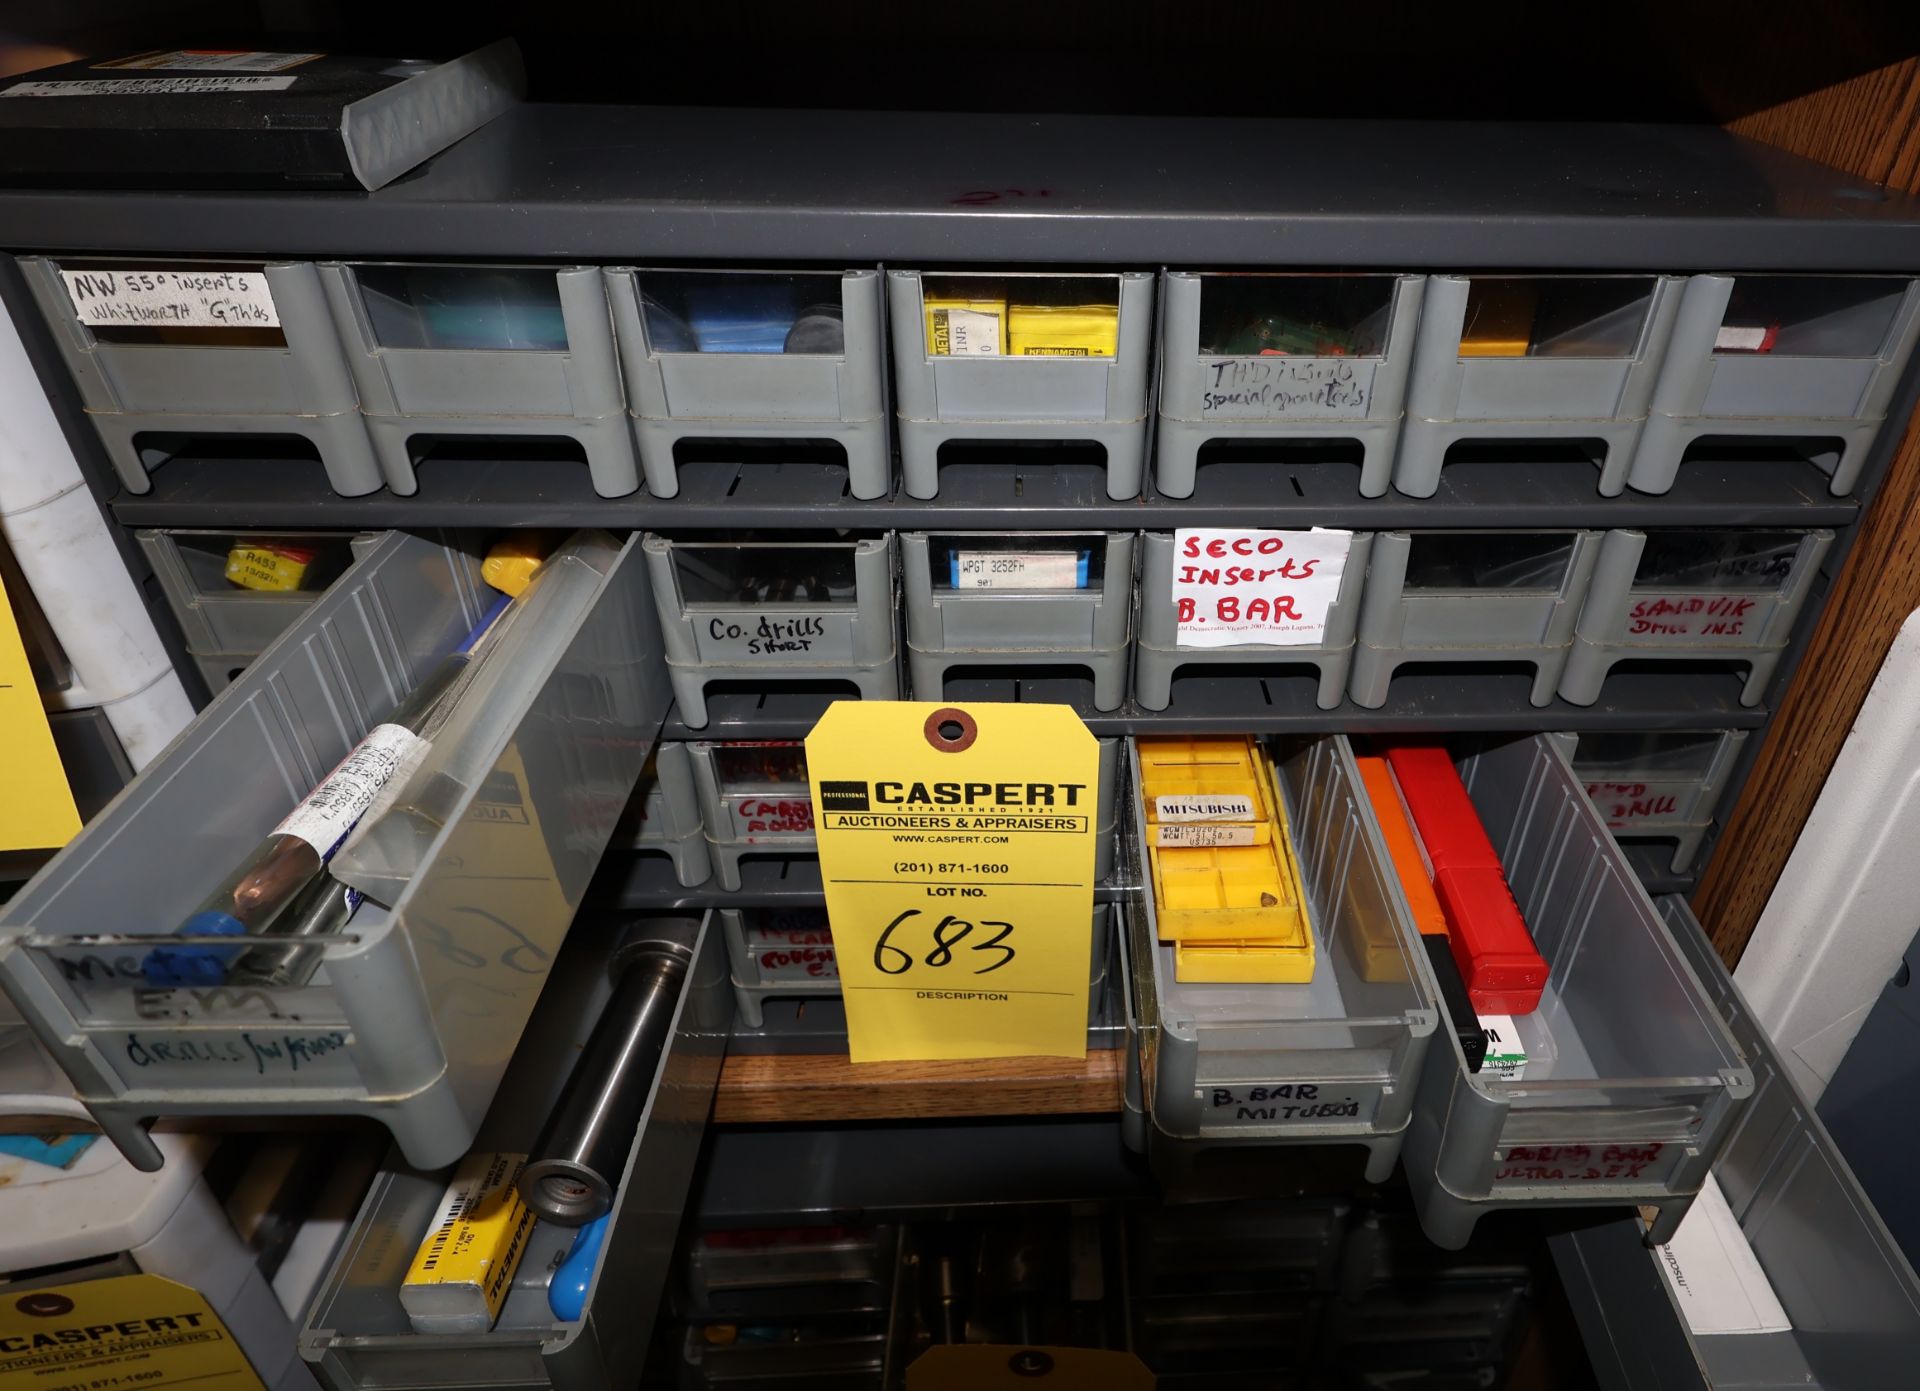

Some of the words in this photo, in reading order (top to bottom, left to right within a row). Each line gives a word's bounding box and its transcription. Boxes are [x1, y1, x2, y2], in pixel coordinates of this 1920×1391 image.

[1183, 536, 1284, 558] SECO
[247, 552, 277, 571] R453
[962, 560, 985, 572] WPGT
[1217, 596, 1303, 624] BAR
[710, 618, 748, 640] Co.
[757, 616, 824, 640] drills
[874, 781, 1087, 806] CASPERT
[1163, 804, 1247, 814] MITSUBISHI
[838, 815, 950, 829] AUCTIONEERS
[955, 817, 969, 829] &
[973, 818, 1077, 830] APPRAISERS
[893, 835, 1009, 844] WWW.CASPERT.COM
[894, 862, 934, 875] (201)
[938, 863, 1009, 874] 871-1600
[927, 887, 956, 896] LOT
[961, 888, 987, 897] NO.
[874, 909, 1015, 974] 683
[917, 991, 1008, 1001] DESCRIPTION
[1250, 1084, 1318, 1101] BAR
